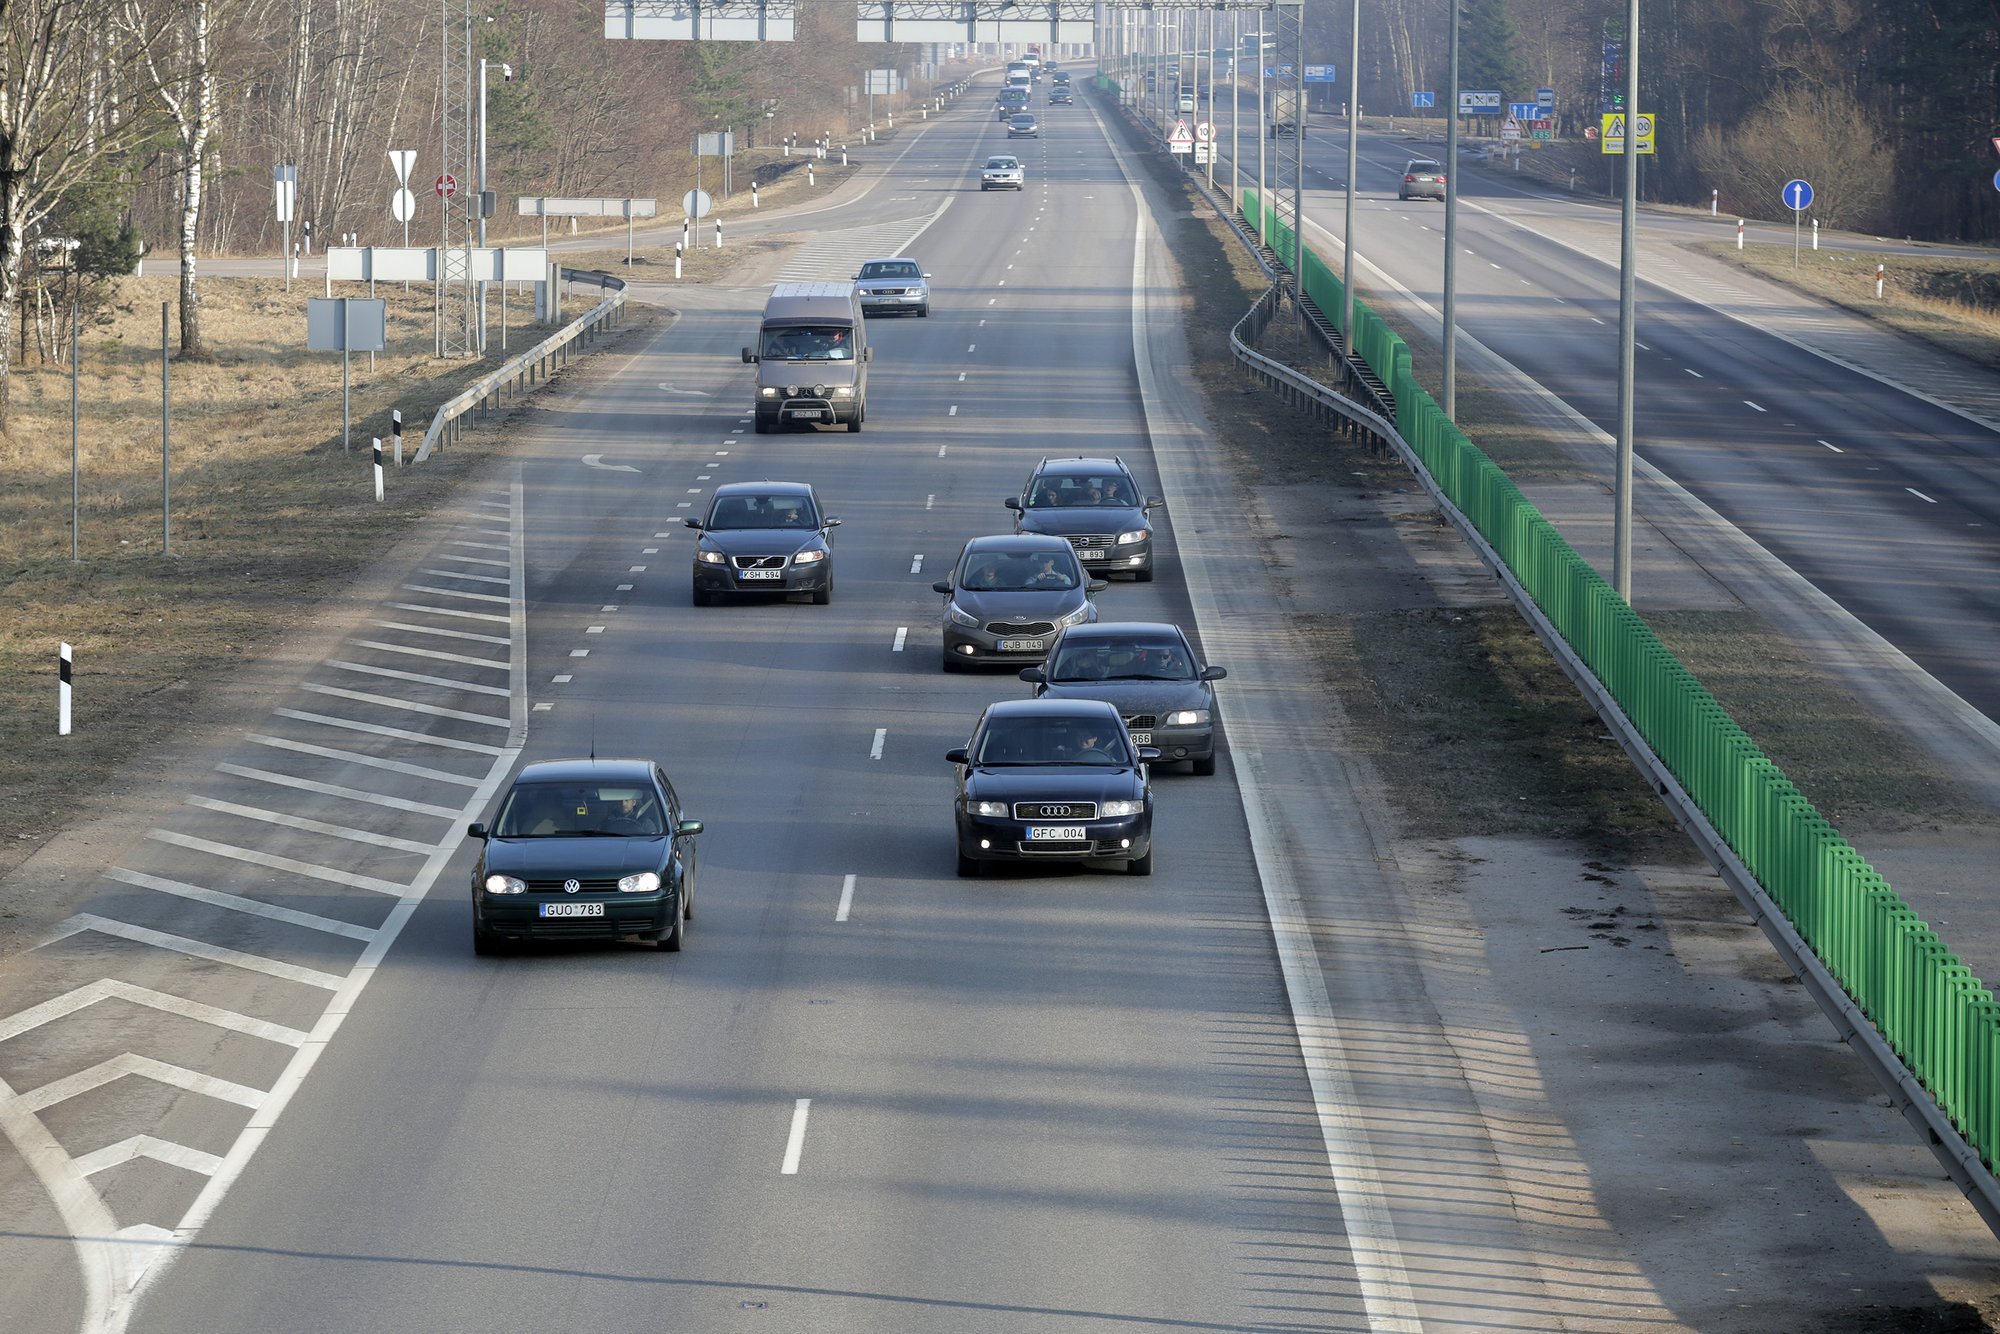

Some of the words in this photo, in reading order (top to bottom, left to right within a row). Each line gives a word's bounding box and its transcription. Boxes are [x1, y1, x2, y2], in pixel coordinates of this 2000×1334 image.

[1090, 551, 1104, 559] 893
[743, 571, 761, 579] KSH
[765, 571, 780, 579] 594
[1002, 641, 1021, 649] GJB
[1026, 641, 1042, 649] 049
[1132, 734, 1150, 744] 866
[1033, 828, 1056, 839] GFC
[1063, 828, 1083, 839] 004
[547, 904, 573, 916] GUO
[580, 904, 602, 915] 783
